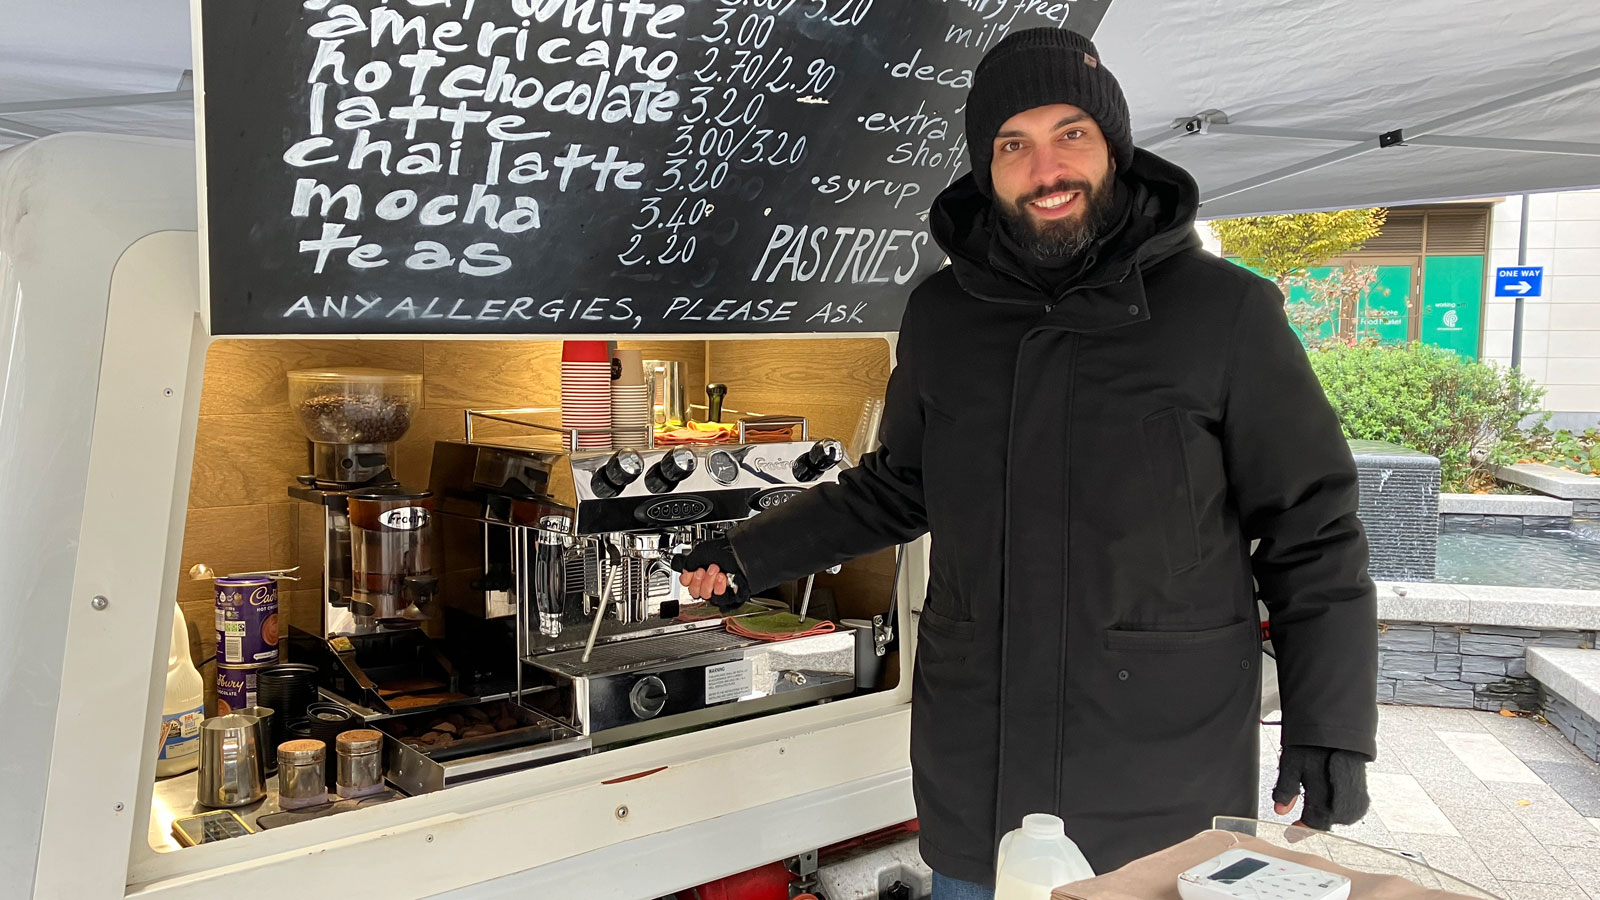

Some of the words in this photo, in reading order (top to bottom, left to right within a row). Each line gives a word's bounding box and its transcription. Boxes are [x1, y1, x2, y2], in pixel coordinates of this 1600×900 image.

[307, 4, 679, 80] americano
[694, 47, 836, 93] 2.70/2.90
[701, 8, 775, 49] 3.00
[310, 82, 551, 140] latte
[667, 124, 806, 166] 3.00/3.20
[683, 86, 765, 126] 3.20
[865, 100, 949, 140] extra
[283, 129, 461, 176] chai
[486, 141, 645, 191] latte
[655, 158, 729, 193] 3.20
[291, 178, 542, 233] mocha
[631, 197, 708, 234] 3.40
[818, 174, 921, 209] syrup
[299, 222, 513, 277] teas
[617, 234, 697, 266] 2.20
[750, 224, 929, 285] PASTRIES
[1499, 269, 1519, 278] ONE
[1521, 269, 1541, 278] WAY
[283, 294, 383, 319] ANY
[385, 296, 643, 330] ALLERGIES,
[662, 296, 798, 322] PLEASE
[805, 300, 868, 325] ASK
